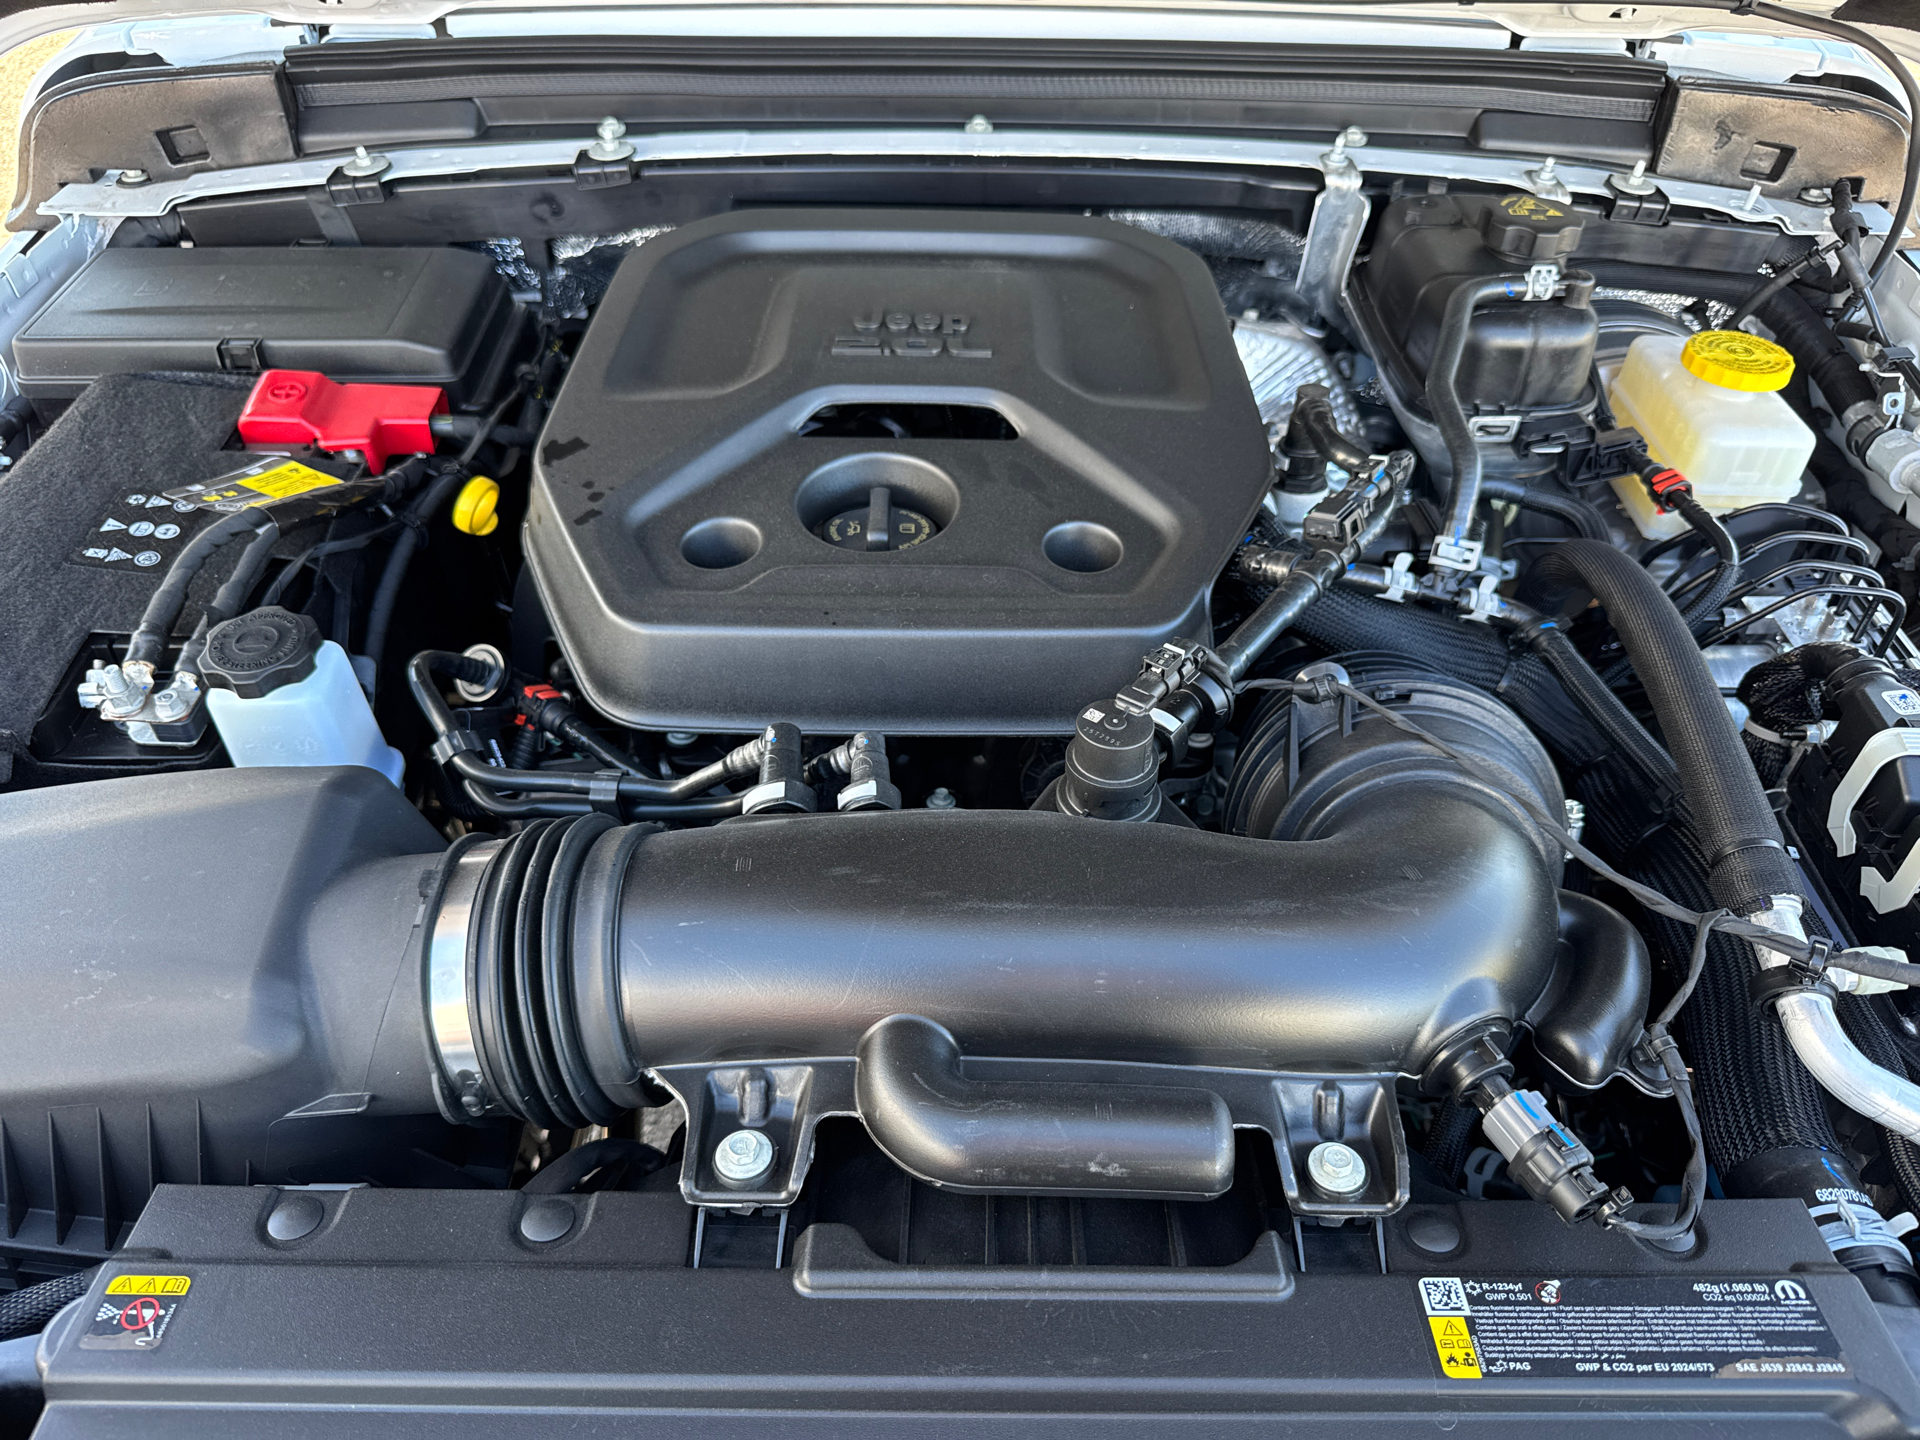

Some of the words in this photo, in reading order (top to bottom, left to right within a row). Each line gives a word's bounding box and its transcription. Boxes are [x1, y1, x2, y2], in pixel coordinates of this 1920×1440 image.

[853, 309, 971, 337] Jeep
[831, 336, 992, 358] 2.0L
[1485, 1293, 1507, 1301] GWP
[1509, 1293, 1533, 1301] 0.501
[1702, 1293, 1724, 1302] CO2
[1509, 1362, 1531, 1371] PAG
[1575, 1362, 1600, 1372] GWP
[1602, 1362, 1612, 1372] &
[1612, 1362, 1635, 1372] CO2
[1636, 1364, 1653, 1373] per
[1654, 1362, 1670, 1372] EU
[1671, 1362, 1715, 1372] 2024/573
[1735, 1362, 1759, 1372] SAE
